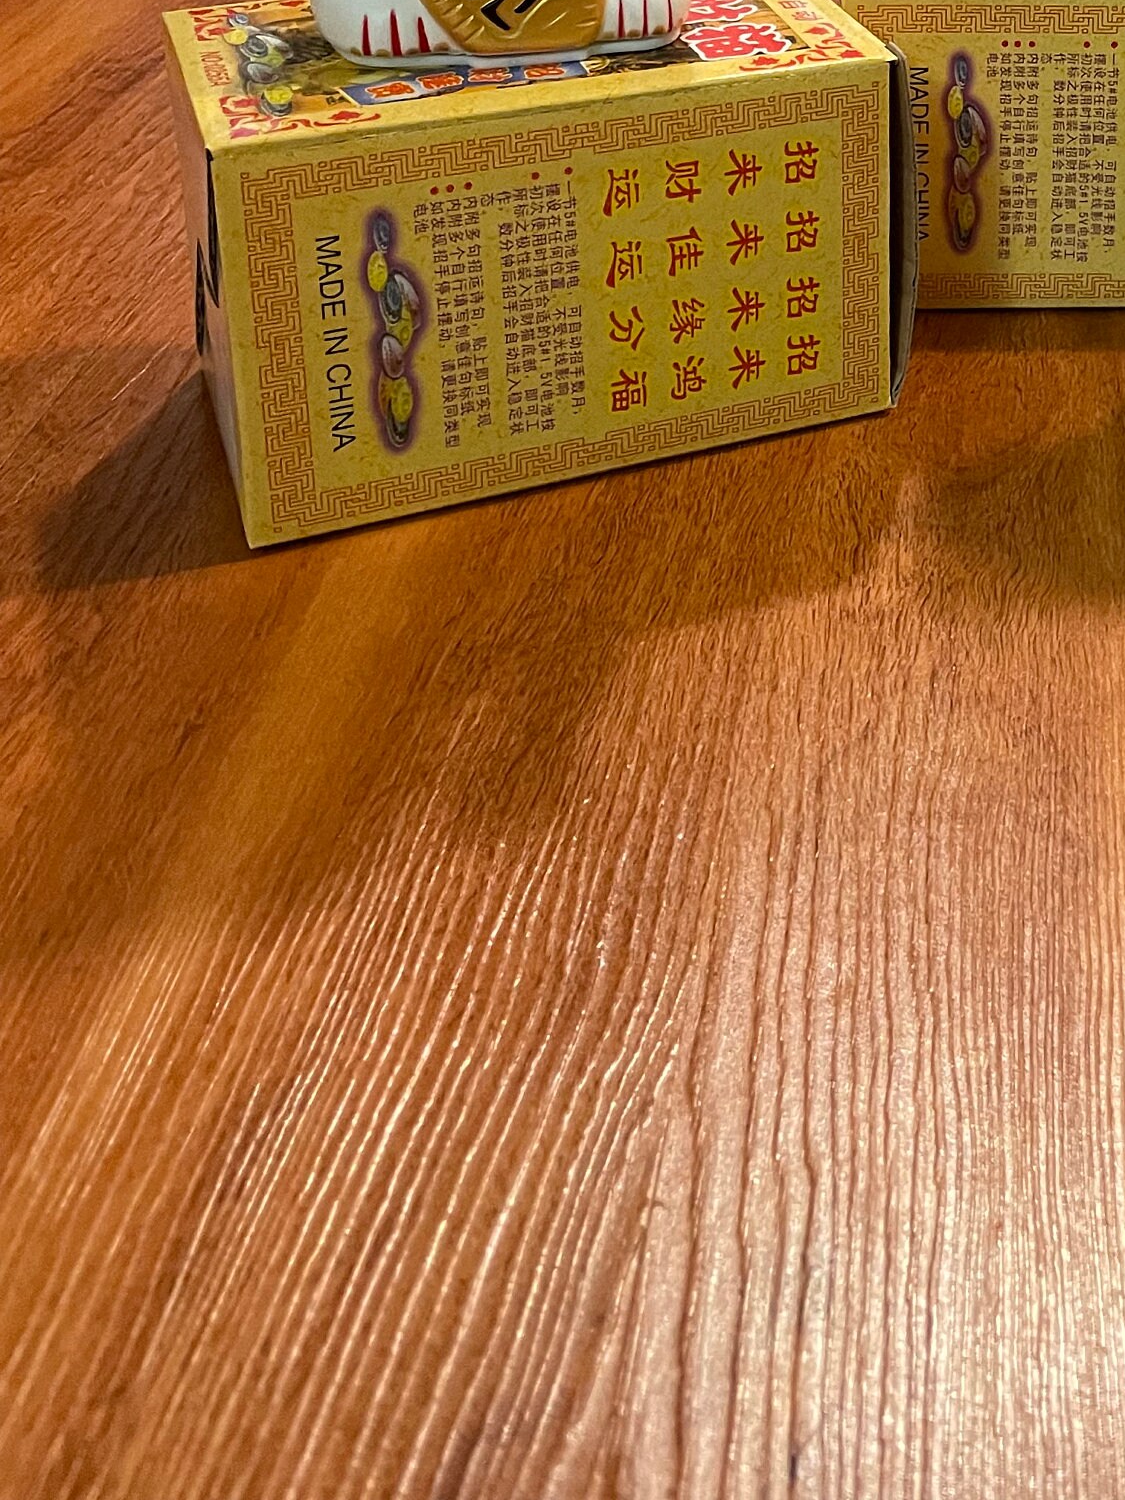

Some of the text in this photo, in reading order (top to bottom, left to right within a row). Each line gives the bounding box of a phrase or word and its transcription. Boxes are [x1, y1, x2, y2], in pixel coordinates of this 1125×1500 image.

[909, 66, 930, 134] MADE
[915, 143, 930, 165] IN
[315, 235, 357, 453] MADE IN CHINA
